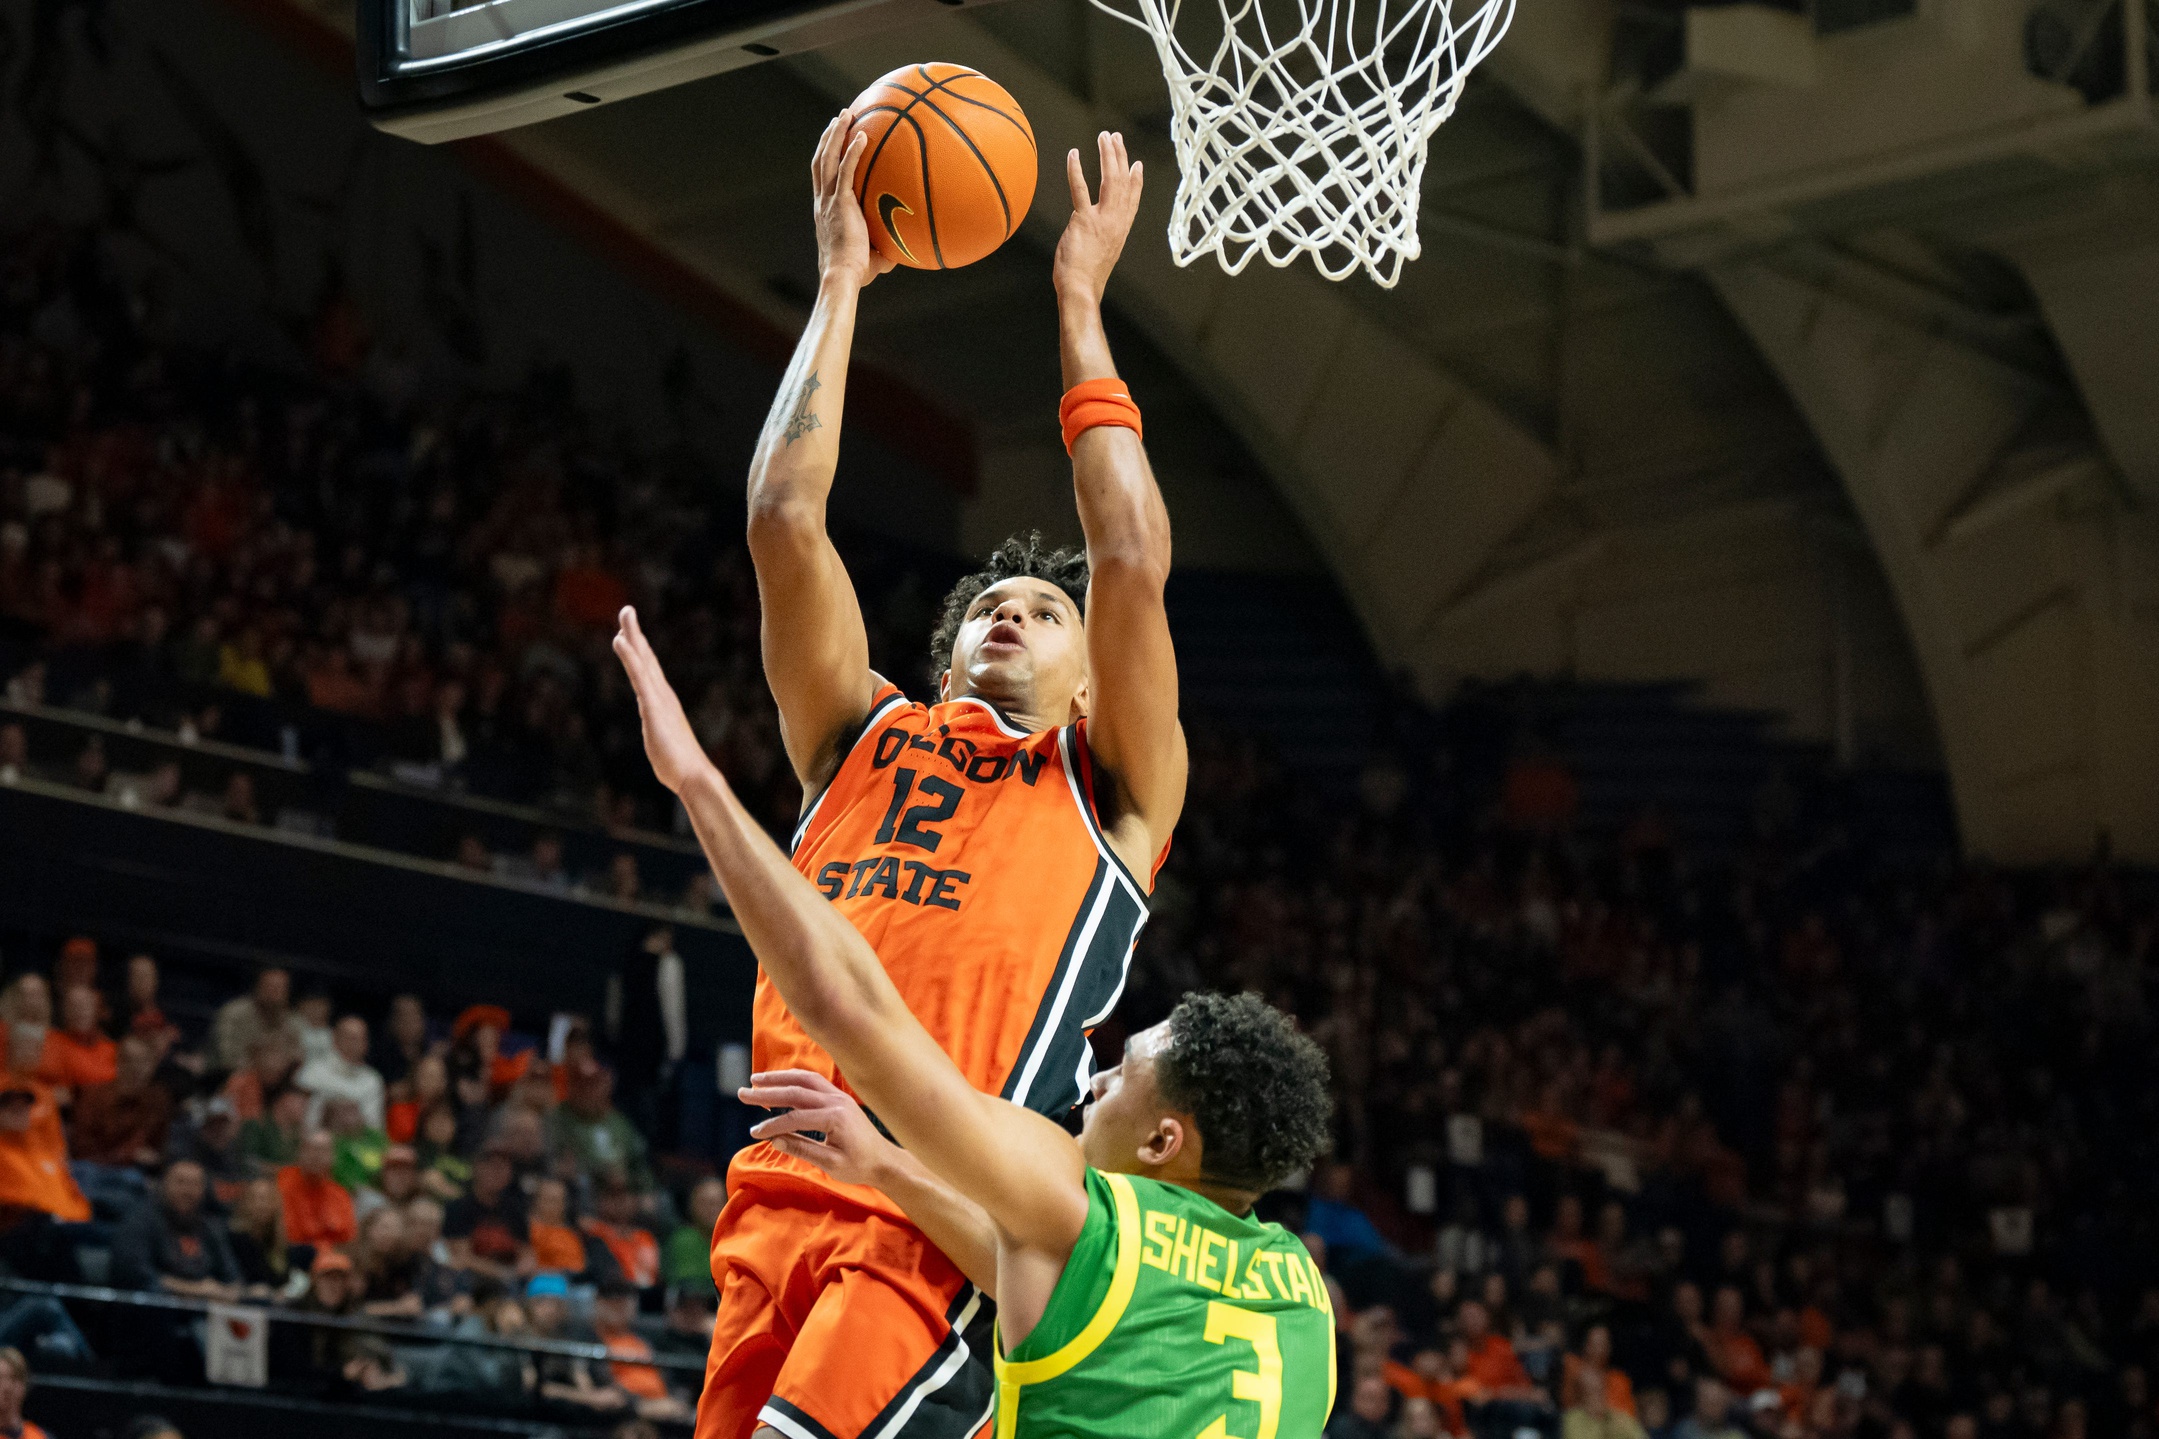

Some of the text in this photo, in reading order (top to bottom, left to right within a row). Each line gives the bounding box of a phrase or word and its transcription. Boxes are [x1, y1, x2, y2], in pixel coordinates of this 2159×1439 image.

[873, 724, 1047, 787] OGON
[873, 767, 965, 853] 12
[816, 856, 972, 911] STATE
[1195, 1300, 1283, 1439] 3
